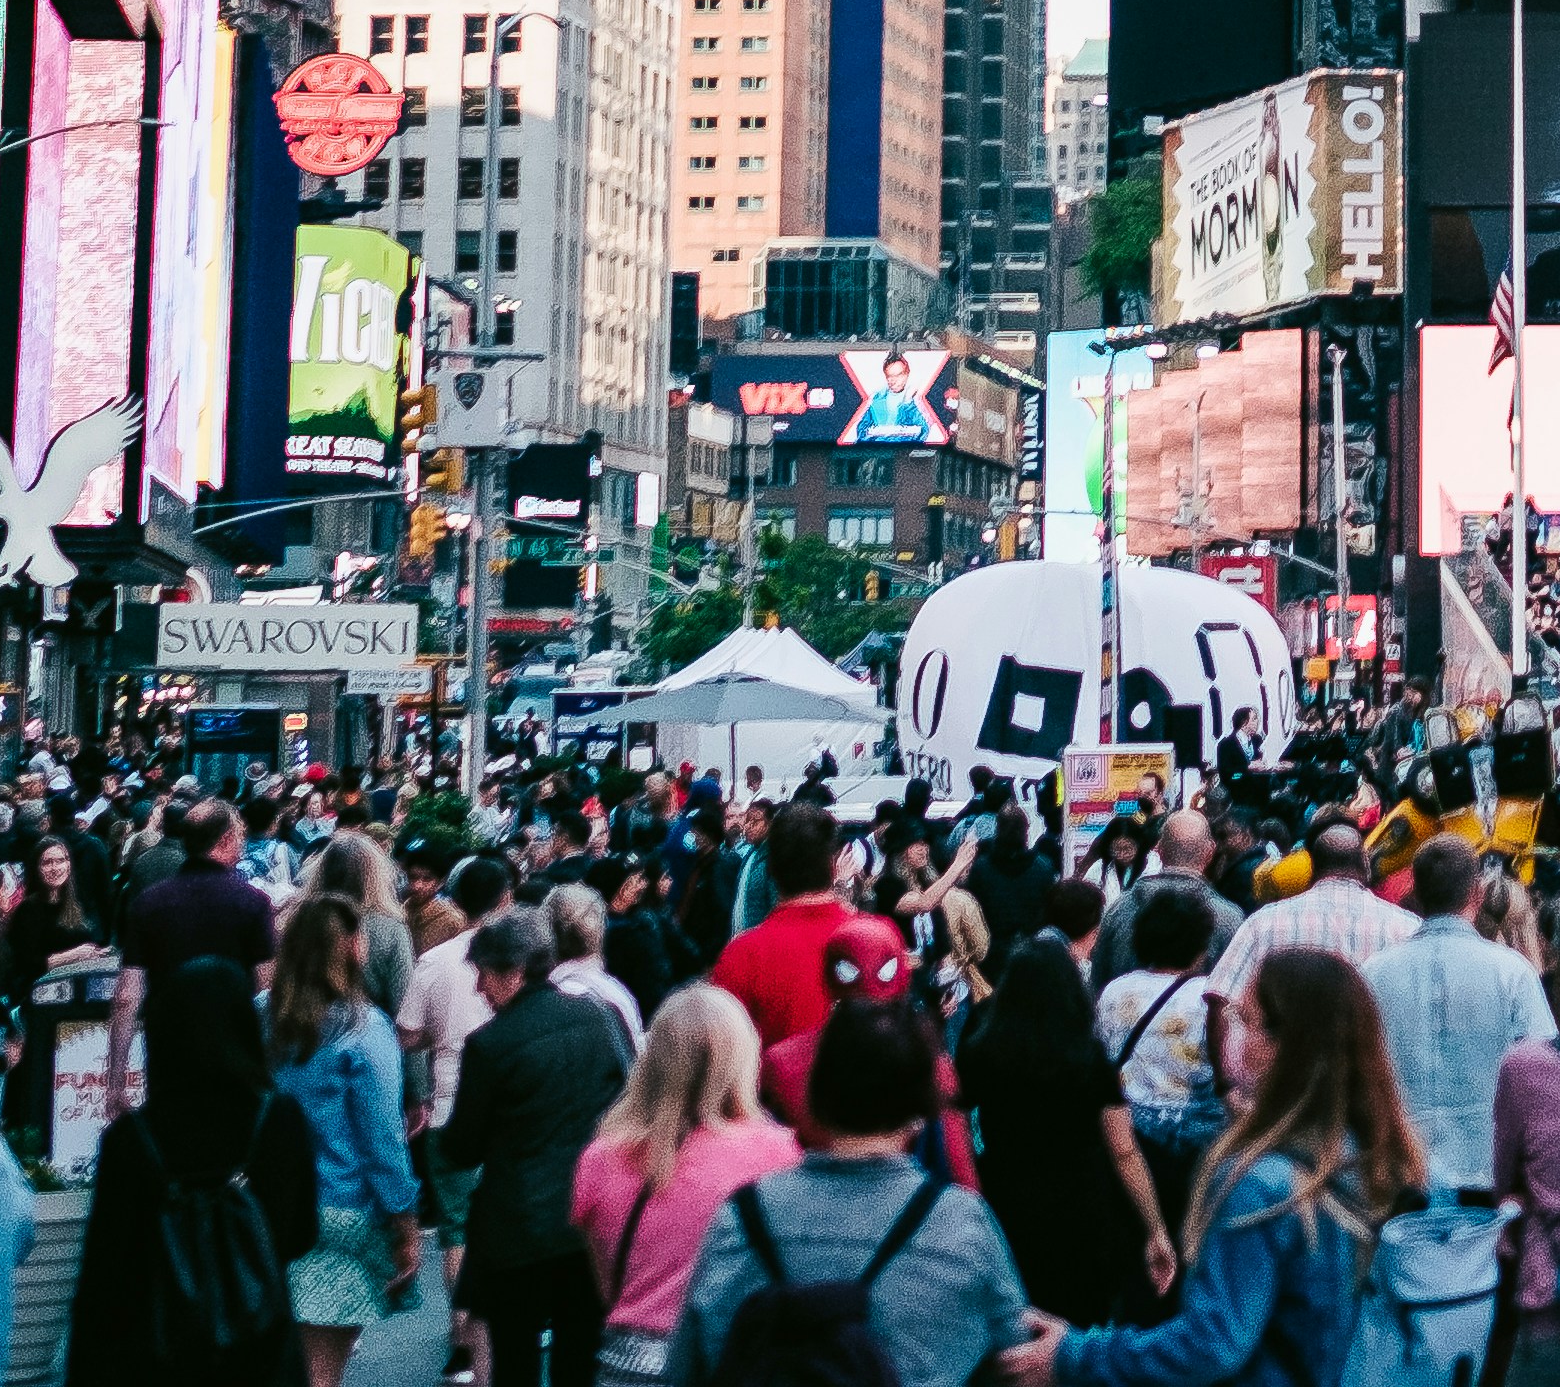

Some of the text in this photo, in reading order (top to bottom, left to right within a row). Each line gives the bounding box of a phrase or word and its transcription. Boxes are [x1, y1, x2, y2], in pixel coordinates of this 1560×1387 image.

[1212, 153, 1242, 195] BOOK
[1341, 85, 1385, 280] HELLO!
[163, 618, 411, 656] SWAROVSKI
